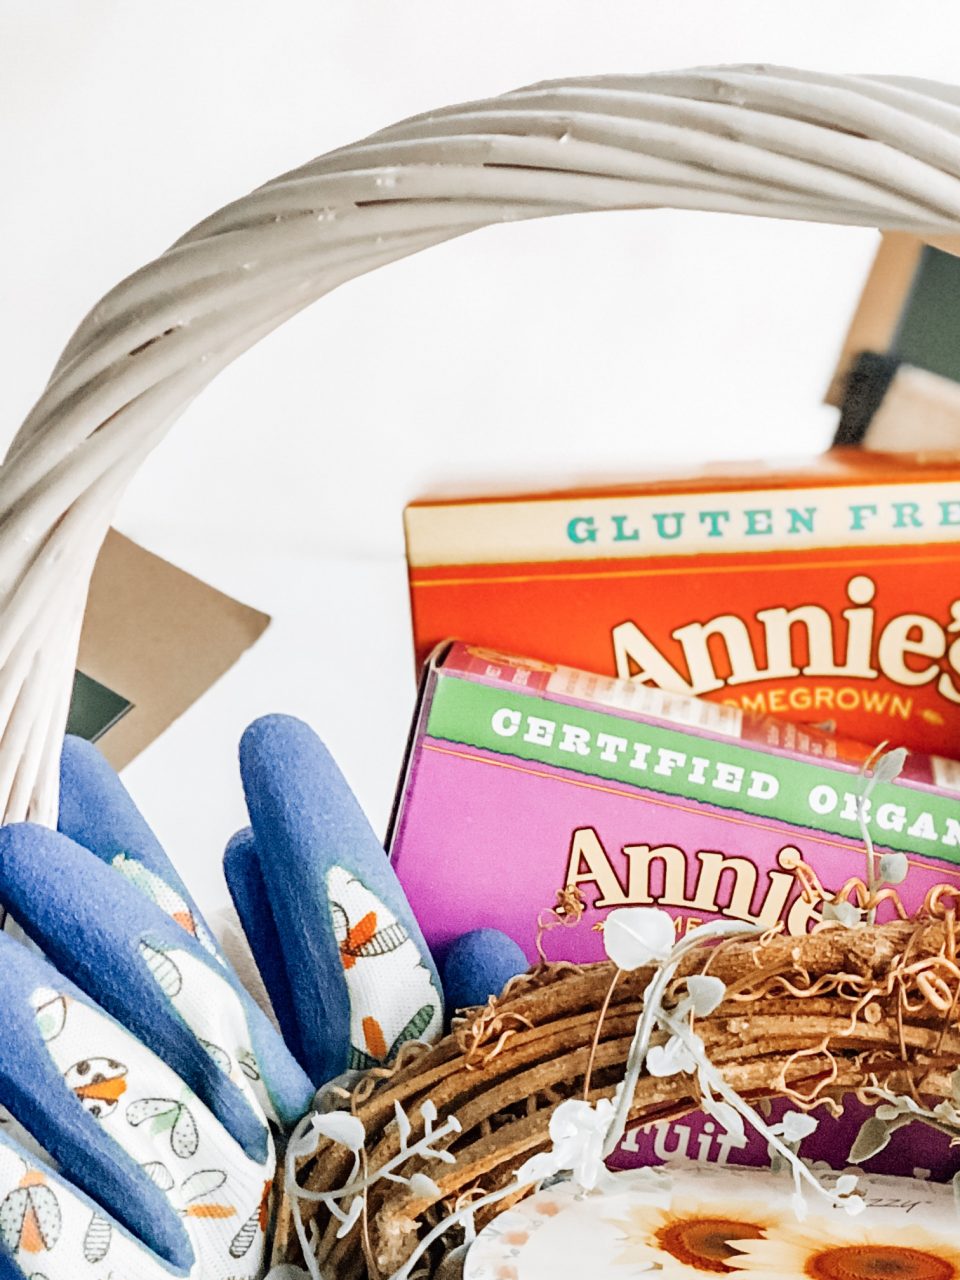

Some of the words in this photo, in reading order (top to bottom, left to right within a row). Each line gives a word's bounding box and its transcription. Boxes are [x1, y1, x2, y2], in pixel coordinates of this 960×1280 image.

[566, 505, 818, 544] GLUTEN
[723, 687, 913, 719] MEGROWN
[491, 708, 780, 802] CERTIFIED
[620, 1119, 749, 1166] ruit
